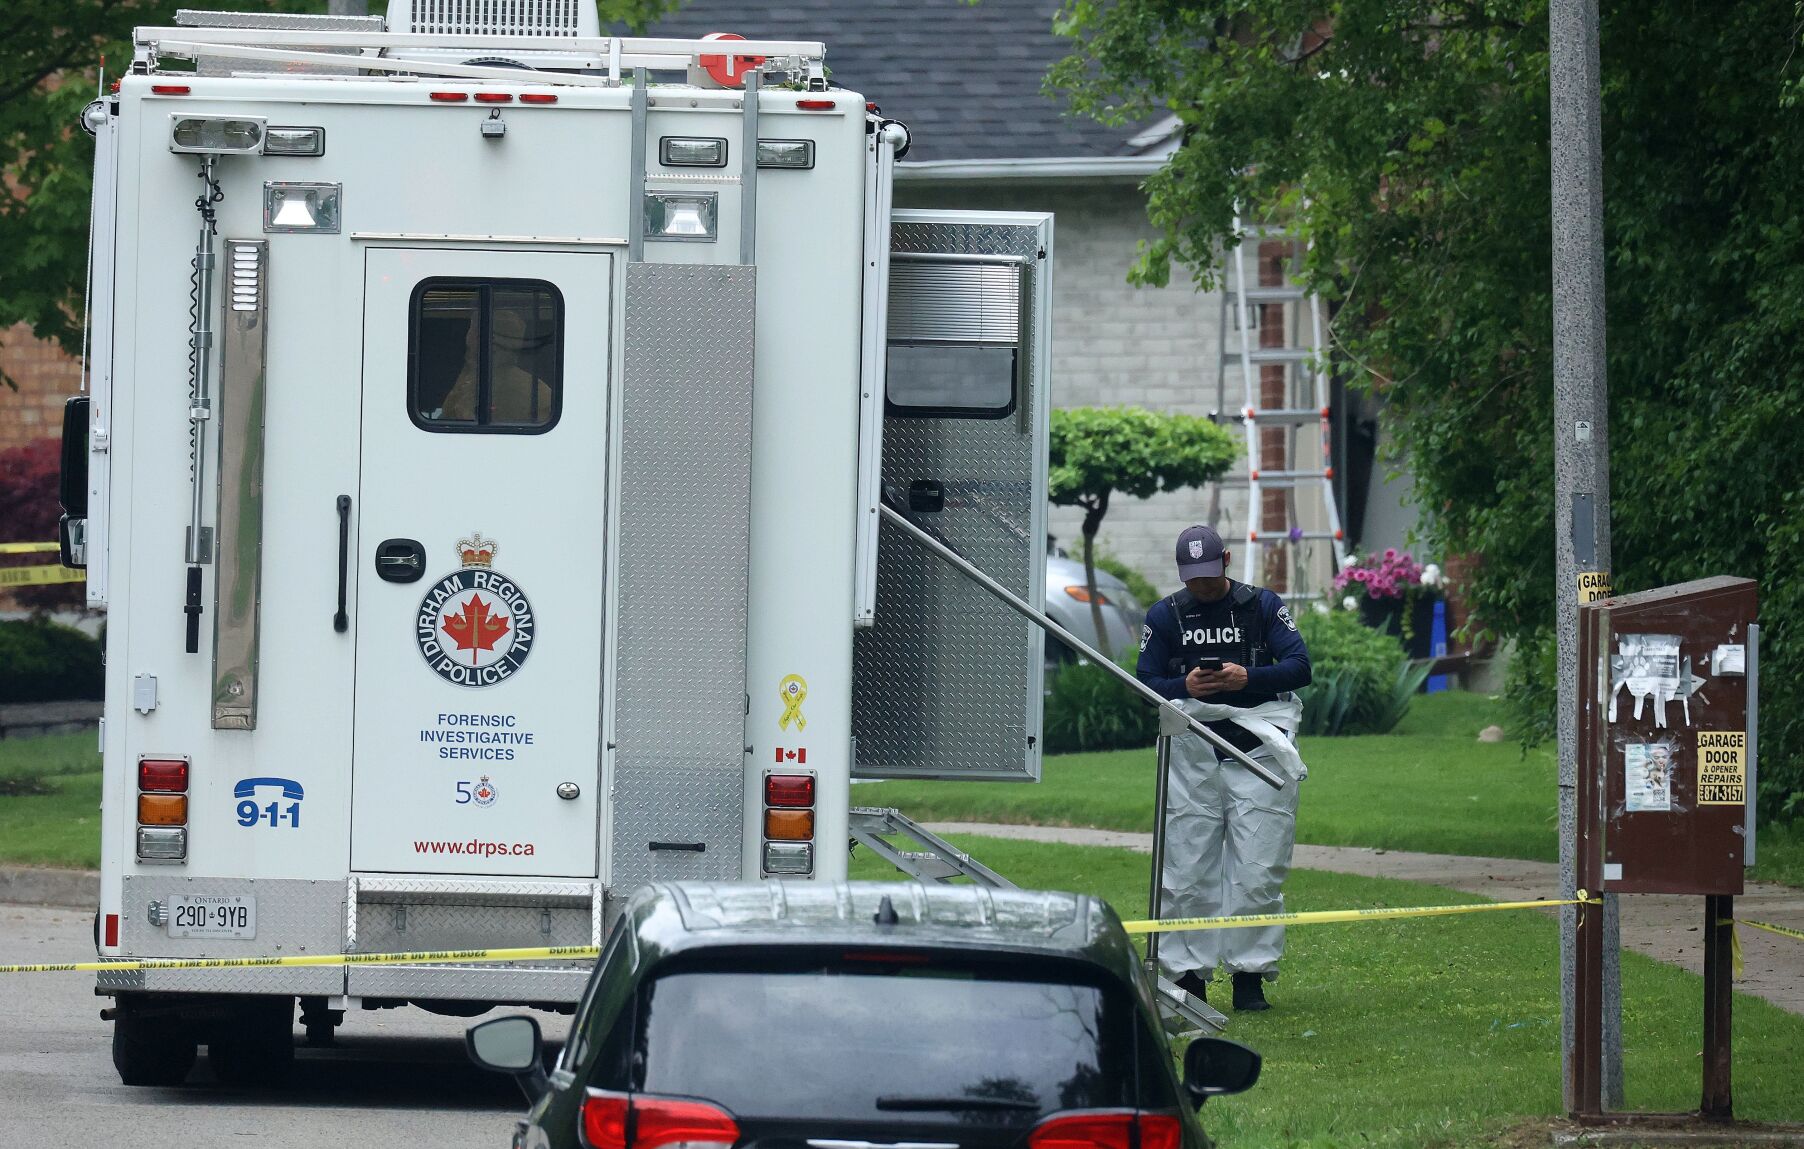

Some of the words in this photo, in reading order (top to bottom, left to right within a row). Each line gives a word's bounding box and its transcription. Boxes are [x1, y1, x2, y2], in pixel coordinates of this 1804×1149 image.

[1583, 574, 1609, 588] GARA
[418, 575, 464, 657] DURHAM
[473, 571, 533, 653] REGIONAL
[1182, 627, 1241, 646] POLICE
[437, 658, 512, 686] POLICE
[438, 714, 516, 727] FORENSIC
[420, 730, 534, 745] INVESTIGATIVE
[1701, 734, 1744, 748] GARAGE
[439, 747, 515, 760] SERVICES
[1706, 751, 1738, 763] DOOR
[1703, 765, 1709, 773] &
[1701, 774, 1742, 784] REPAIRS
[1704, 785, 1743, 801] 871-3157
[236, 800, 300, 828] 9-1-1
[414, 839, 534, 858] www.drps.ca
[176, 905, 206, 927] 290
[217, 906, 247, 927] 9YB
